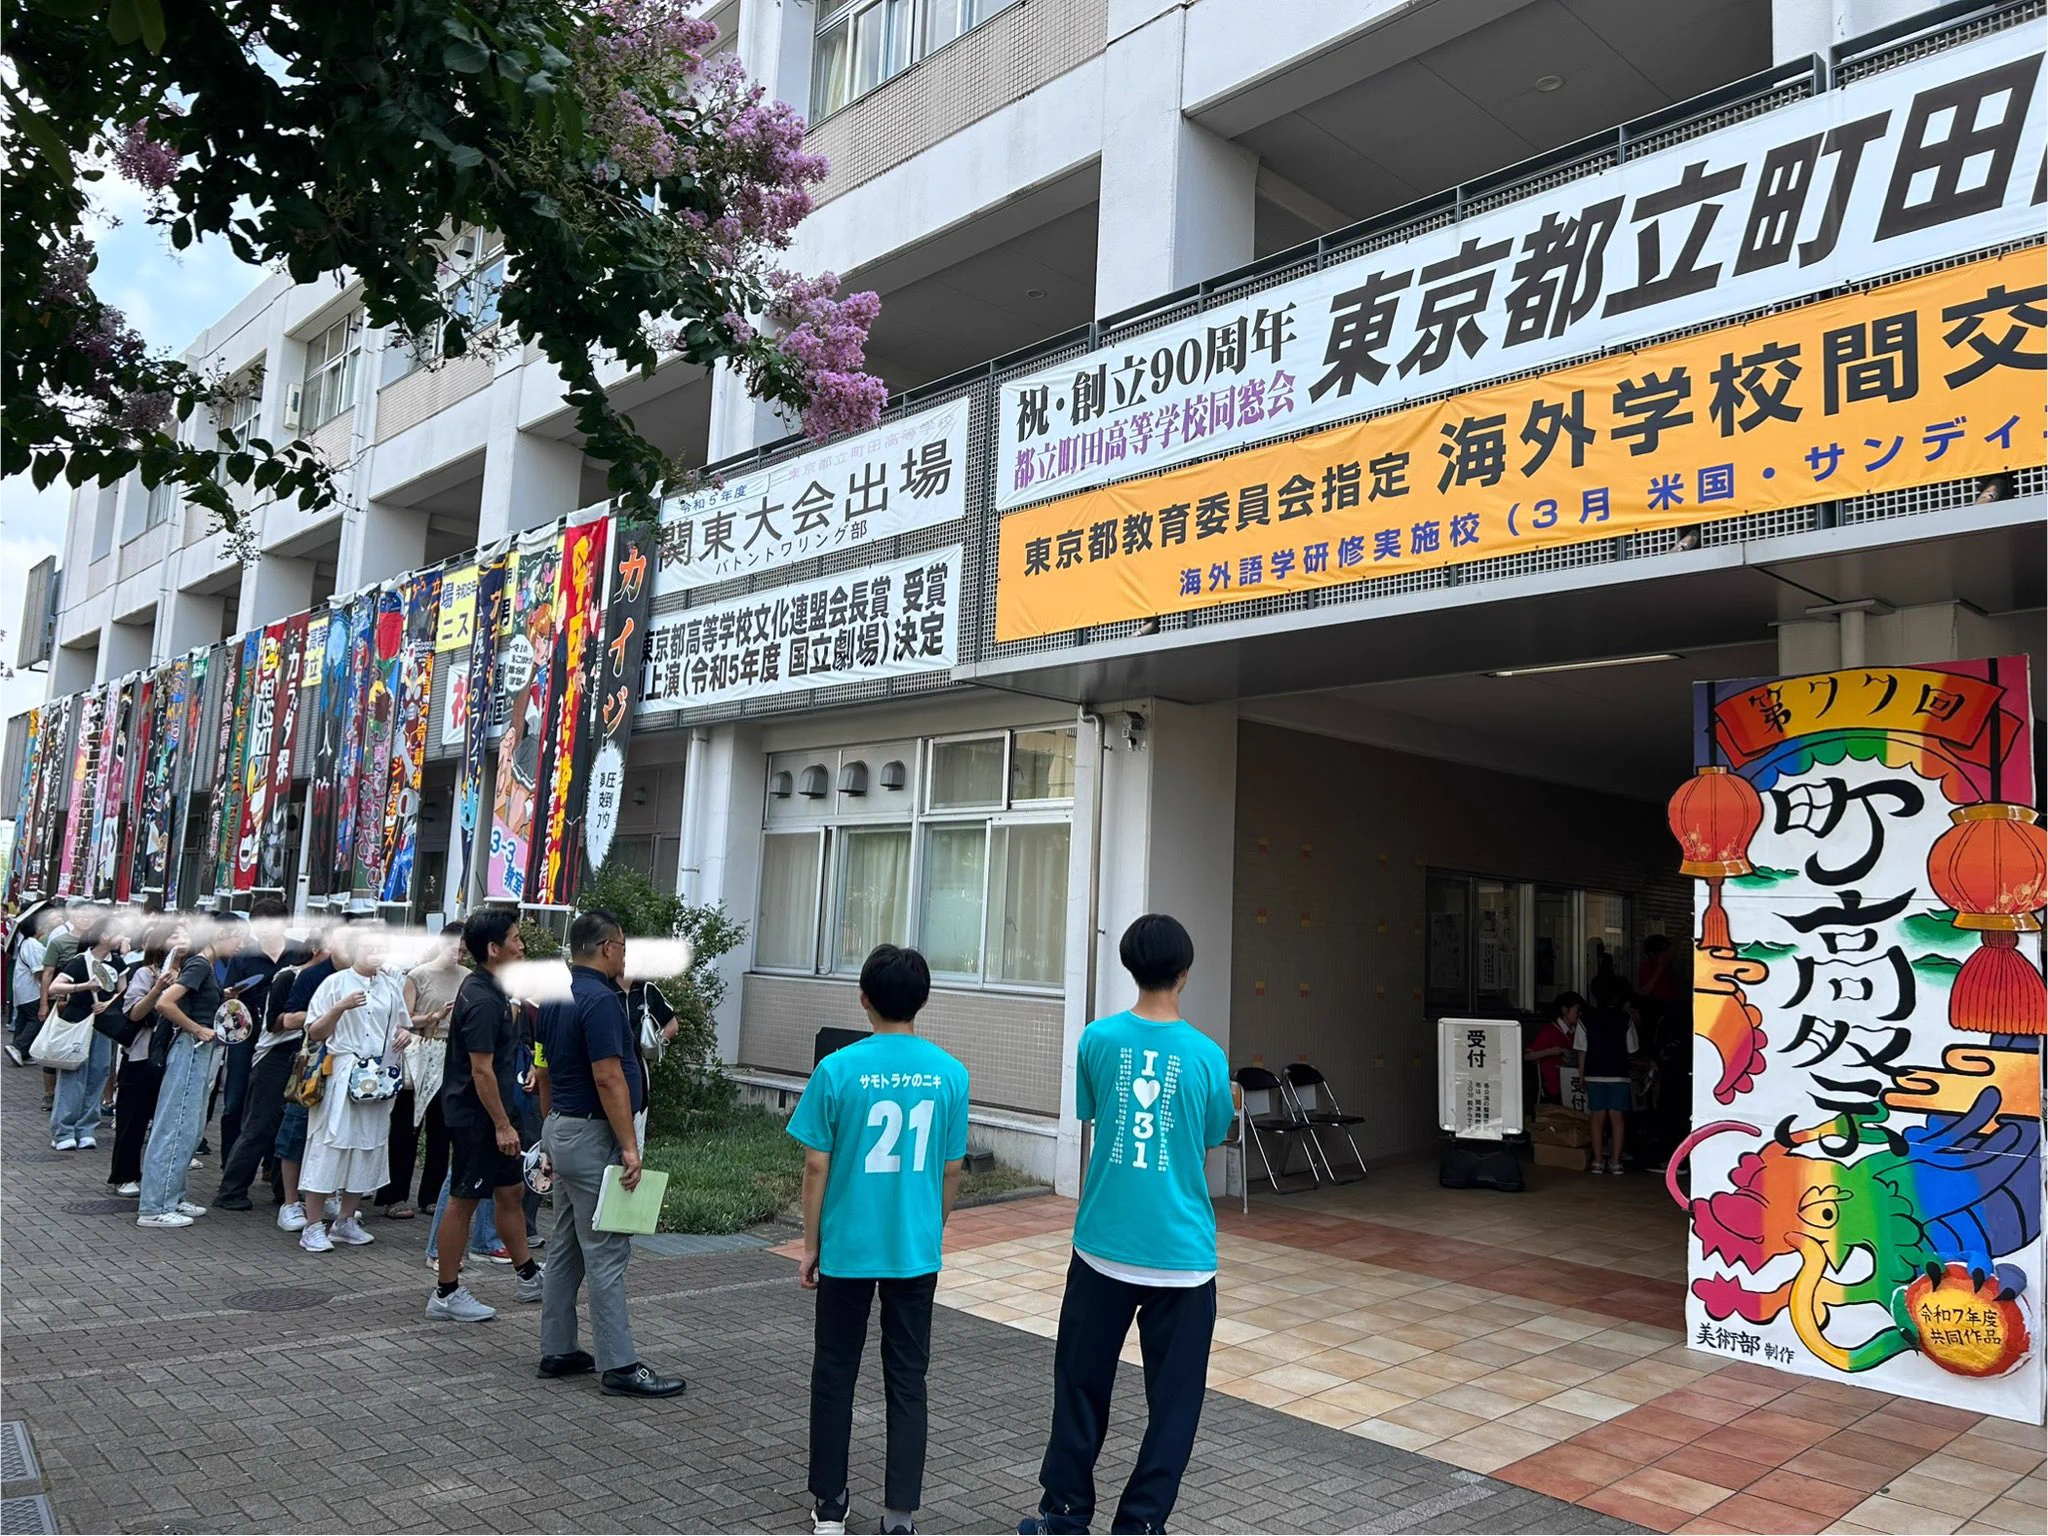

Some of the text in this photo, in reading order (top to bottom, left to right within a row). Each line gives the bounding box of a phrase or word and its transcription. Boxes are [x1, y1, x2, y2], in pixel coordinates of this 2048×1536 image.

[1309, 51, 2048, 404] 東京都立町田
[1016, 302, 1297, 443] 祝・創立90周年
[787, 414, 957, 481] 東京都立町田高等学校
[1014, 369, 1297, 491] 都立町田高等学校同窓会
[1024, 284, 2048, 577] 東京都教育委員会指定 海外学校間交
[1646, 404, 2048, 512] 米国・サンディ
[658, 438, 953, 573] 関東大会出場
[679, 484, 749, 514] 令和5年度
[714, 519, 869, 575] バトントワリング部
[602, 547, 647, 740] カイジ
[640, 574, 892, 665] 東京都高等学校文化連盟会長賞
[902, 561, 949, 614] 受賞
[638, 641, 782, 703] 上演(令和5年度
[1772, 776, 1927, 1159] 町高祭
[859, 1072, 942, 1090] サモトラケのニキ
[1467, 1029, 1487, 1069] 受付
[864, 1099, 935, 1174] 21
[1695, 1321, 1796, 1365] 美術部 制作
[1919, 1302, 1998, 1329] 令和7年度
[1929, 1325, 2002, 1347] 共同作品
